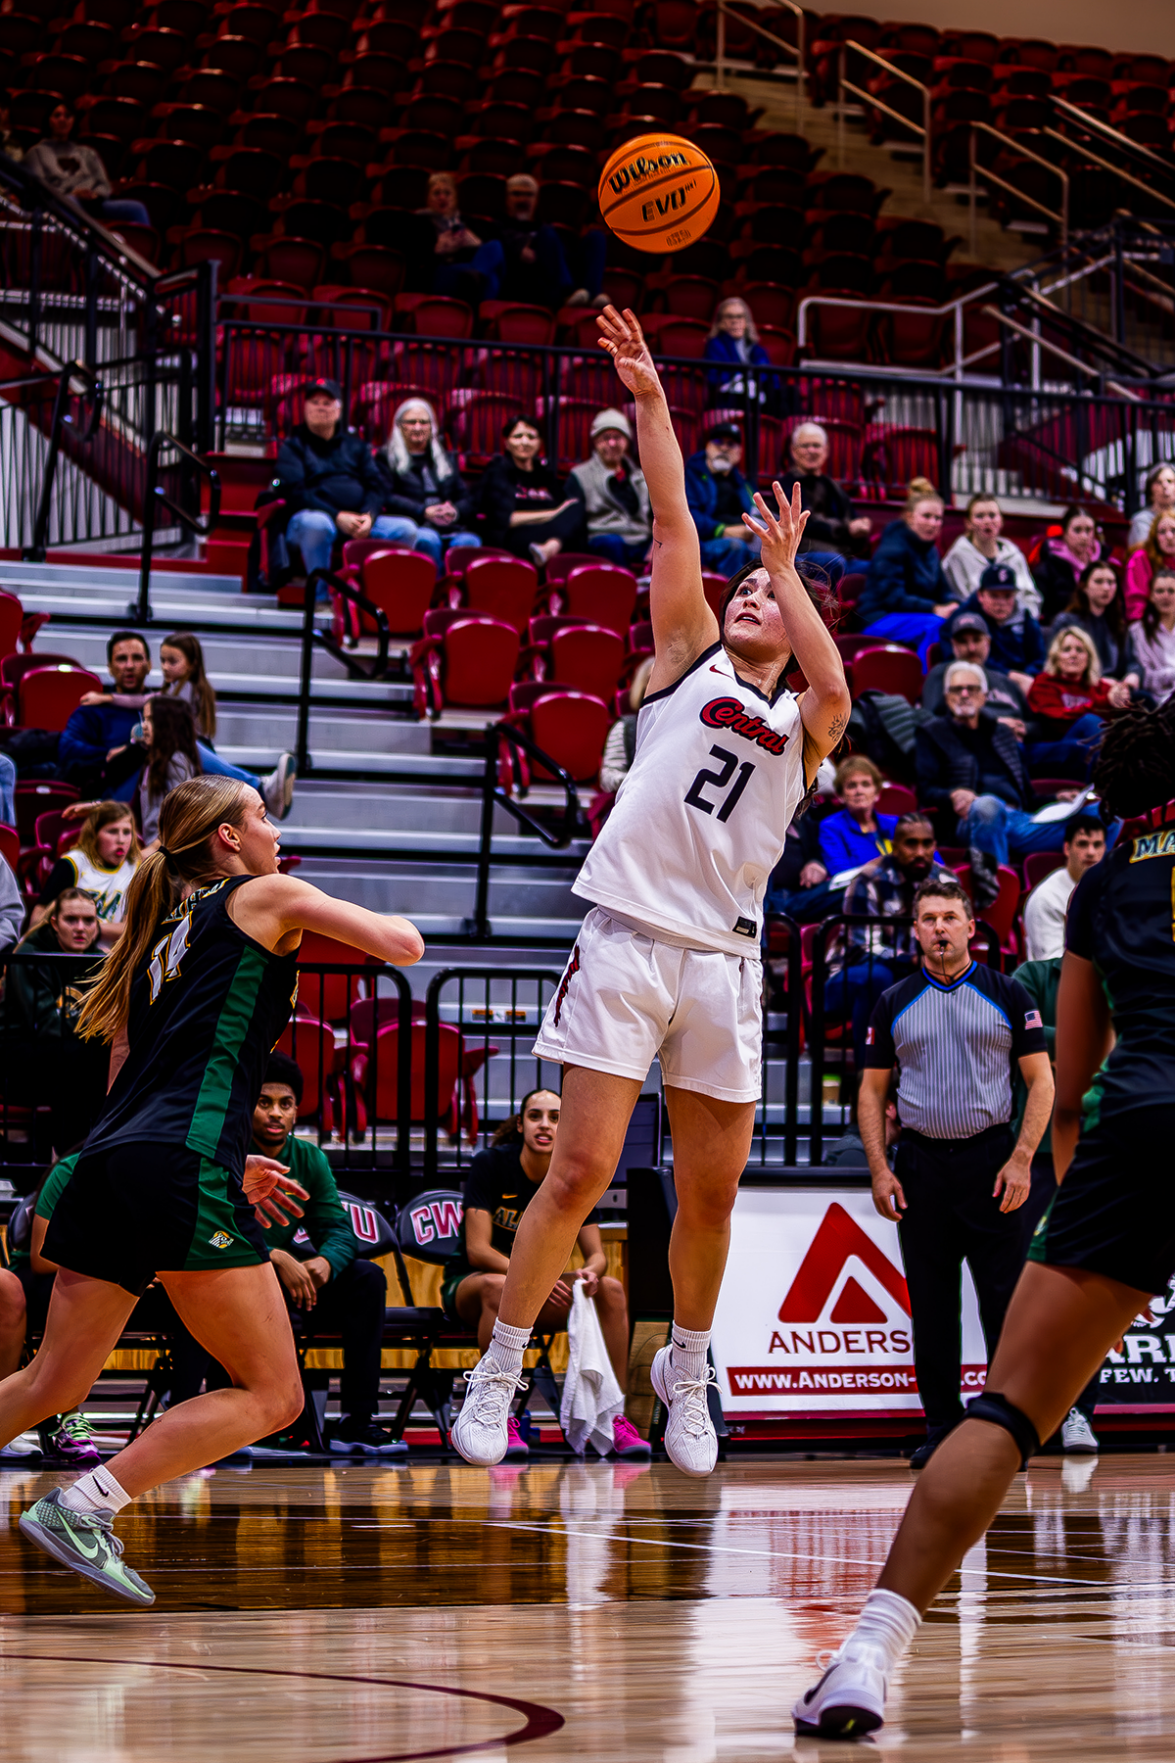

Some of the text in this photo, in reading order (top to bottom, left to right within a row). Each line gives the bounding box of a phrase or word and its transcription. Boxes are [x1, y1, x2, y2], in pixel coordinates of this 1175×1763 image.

[608, 152, 690, 195] Wilson
[642, 186, 686, 222] EVO
[699, 696, 789, 756] Central
[684, 743, 756, 823] 21
[147, 910, 191, 1005] 14
[492, 1206, 523, 1232] AL
[1100, 1367, 1159, 1383] FEW.
